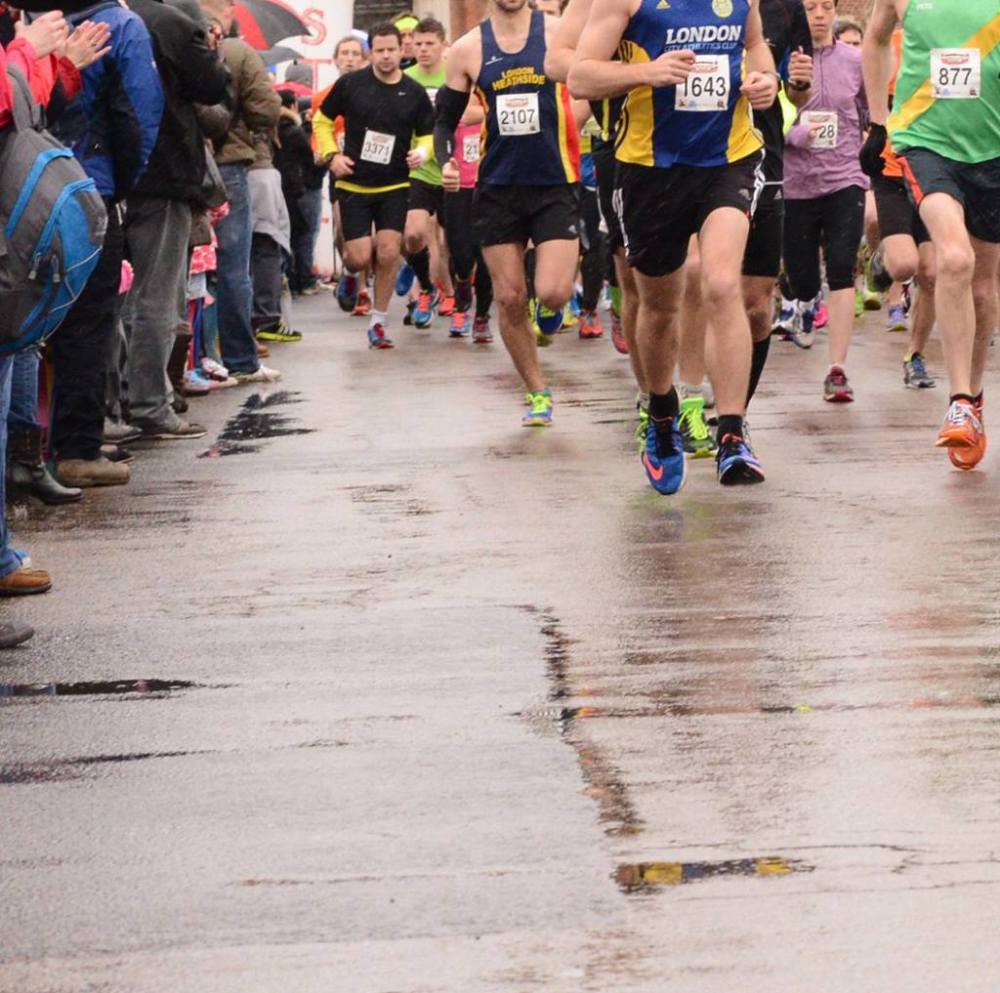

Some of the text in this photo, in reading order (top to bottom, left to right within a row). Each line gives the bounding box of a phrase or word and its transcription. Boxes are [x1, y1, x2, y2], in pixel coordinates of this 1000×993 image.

[665, 24, 742, 45] LONDON
[492, 74, 546, 91] HEATHSIDE
[939, 68, 972, 85] 877
[684, 76, 726, 97] 1643
[500, 109, 535, 124] 2107
